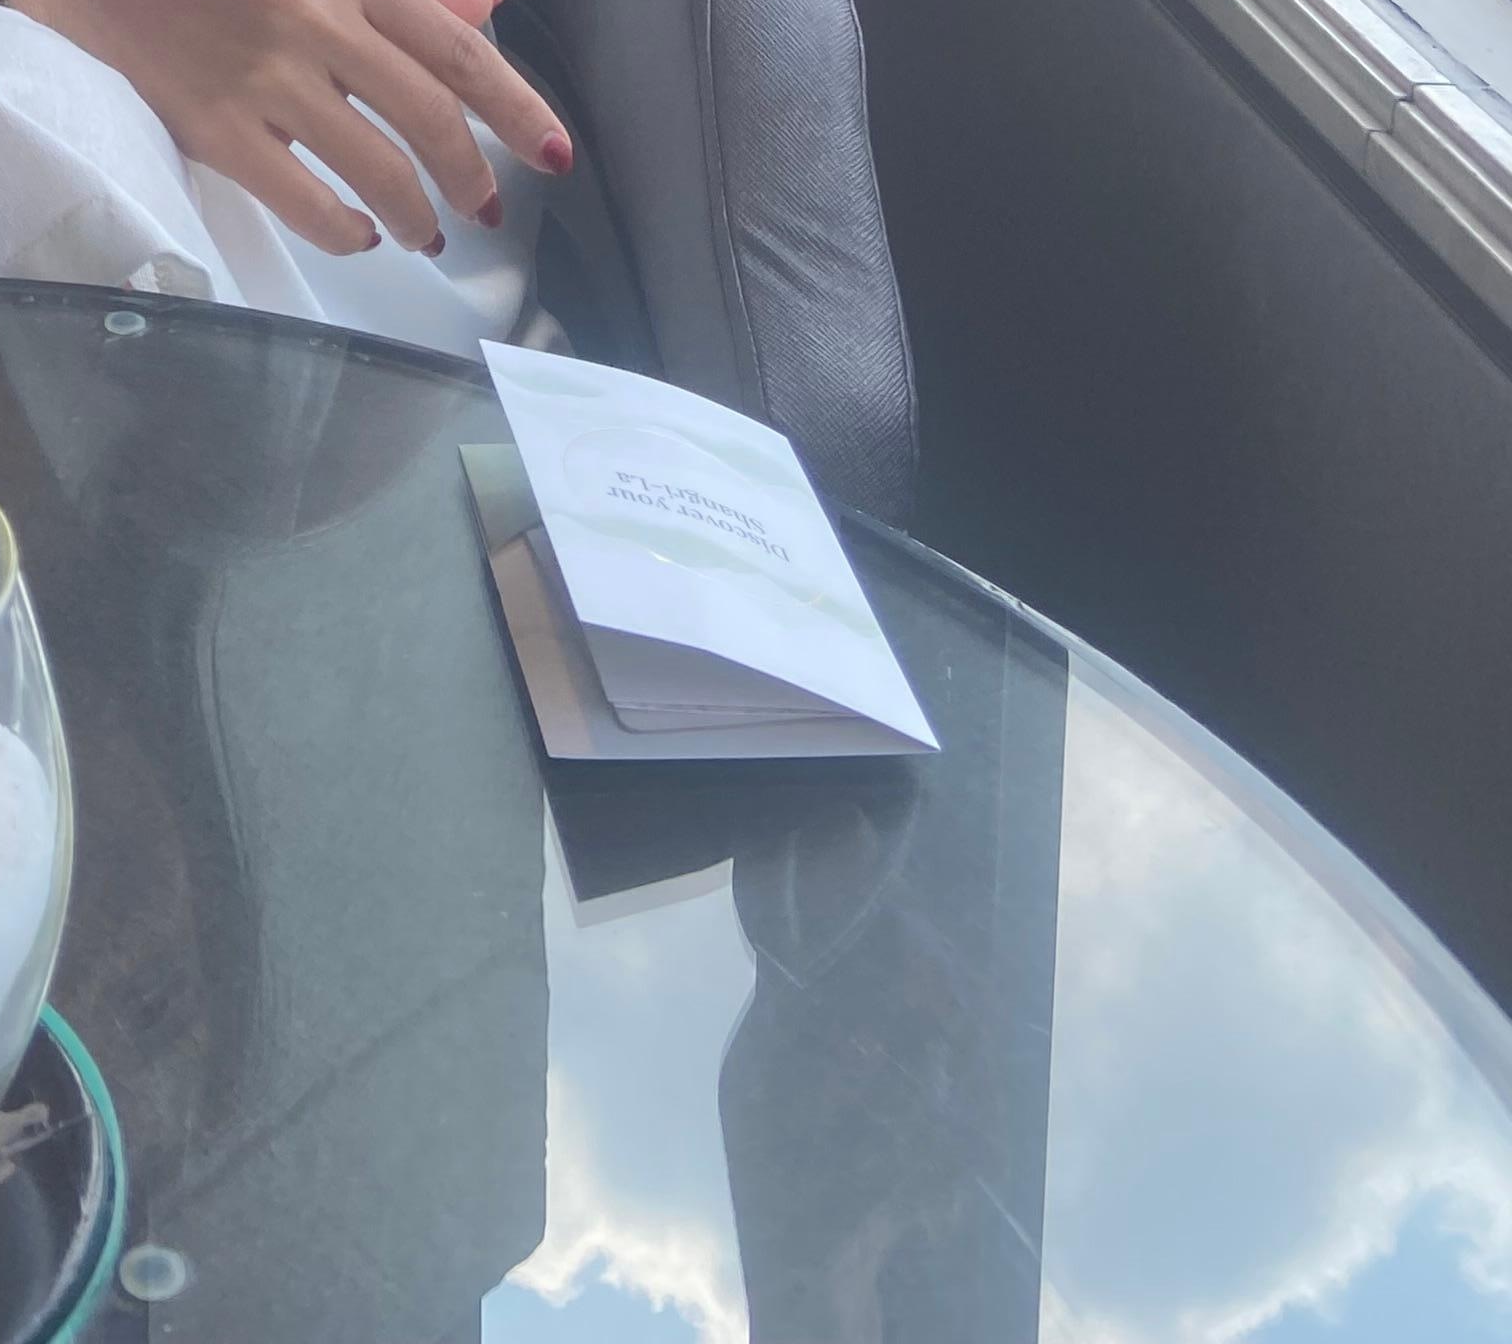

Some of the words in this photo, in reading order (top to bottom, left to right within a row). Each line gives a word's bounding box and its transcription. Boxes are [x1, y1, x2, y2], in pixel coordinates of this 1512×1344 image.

[606, 486, 671, 511] your
[615, 471, 766, 535] Shangri-La
[678, 505, 790, 562] Discover
